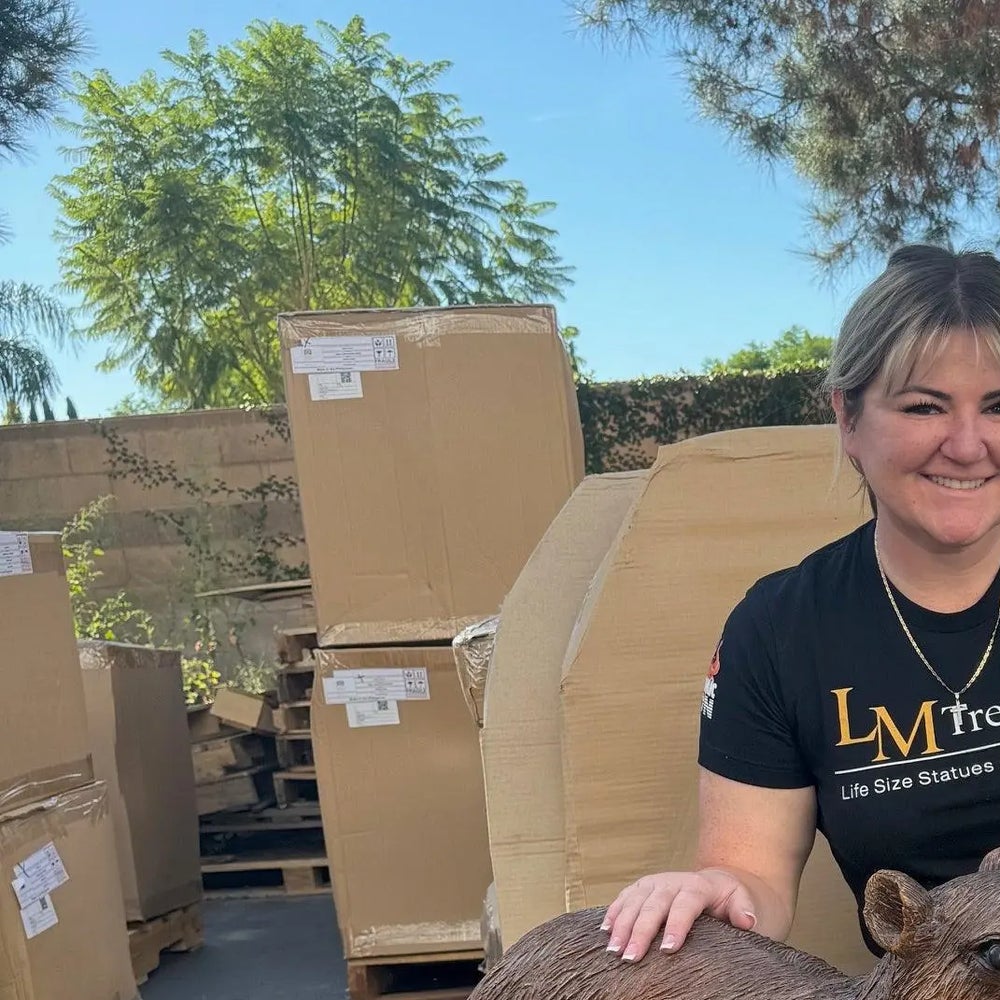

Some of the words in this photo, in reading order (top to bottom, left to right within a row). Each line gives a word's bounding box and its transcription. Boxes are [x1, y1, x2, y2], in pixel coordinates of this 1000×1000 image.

[831, 687, 944, 762] LM
[841, 783, 869, 801] Life
[874, 777, 913, 794] Size
[919, 760, 994, 785] Statues
